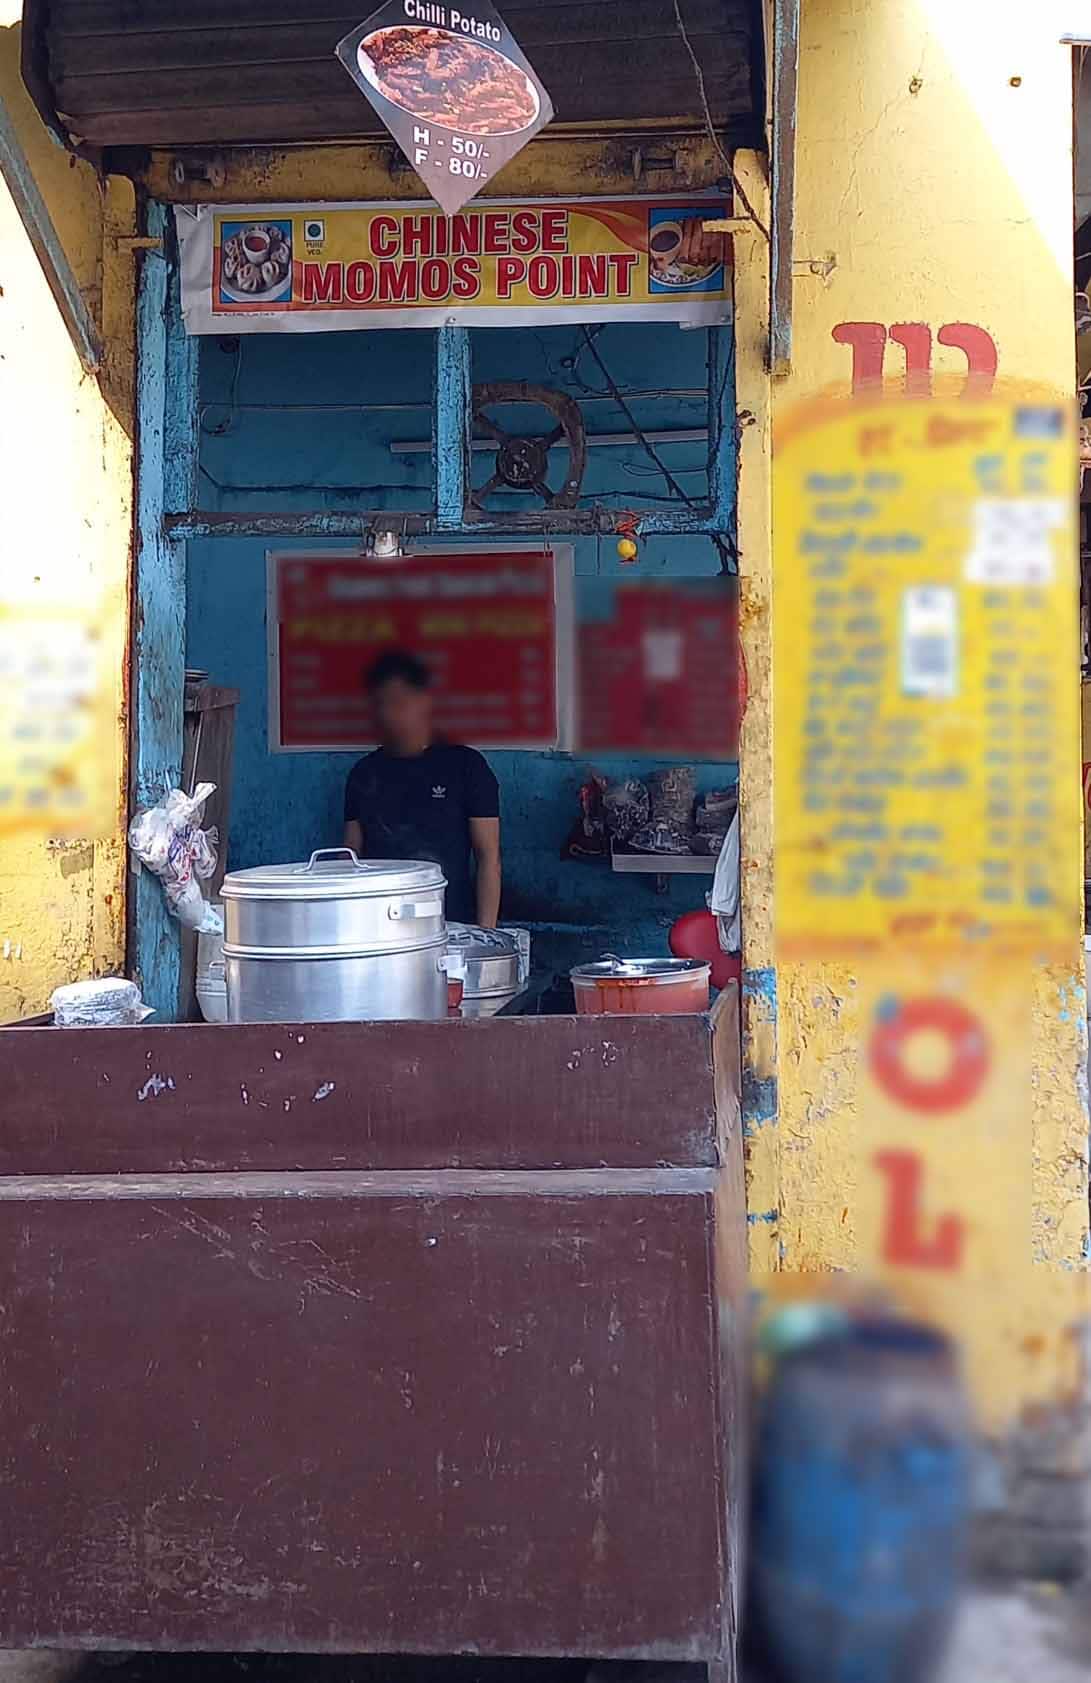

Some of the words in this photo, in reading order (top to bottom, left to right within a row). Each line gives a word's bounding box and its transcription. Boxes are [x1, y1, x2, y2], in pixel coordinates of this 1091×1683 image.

[404, 0, 446, 26] Chilli
[450, 9, 501, 42] Potato
[413, 126, 430, 146] H
[451, 135, 491, 160] 50/-
[415, 148, 429, 165] F
[448, 156, 488, 180] 80/-
[368, 210, 568, 259] CHINESE
[302, 255, 481, 304] MOMOS
[495, 253, 639, 299] POINT
